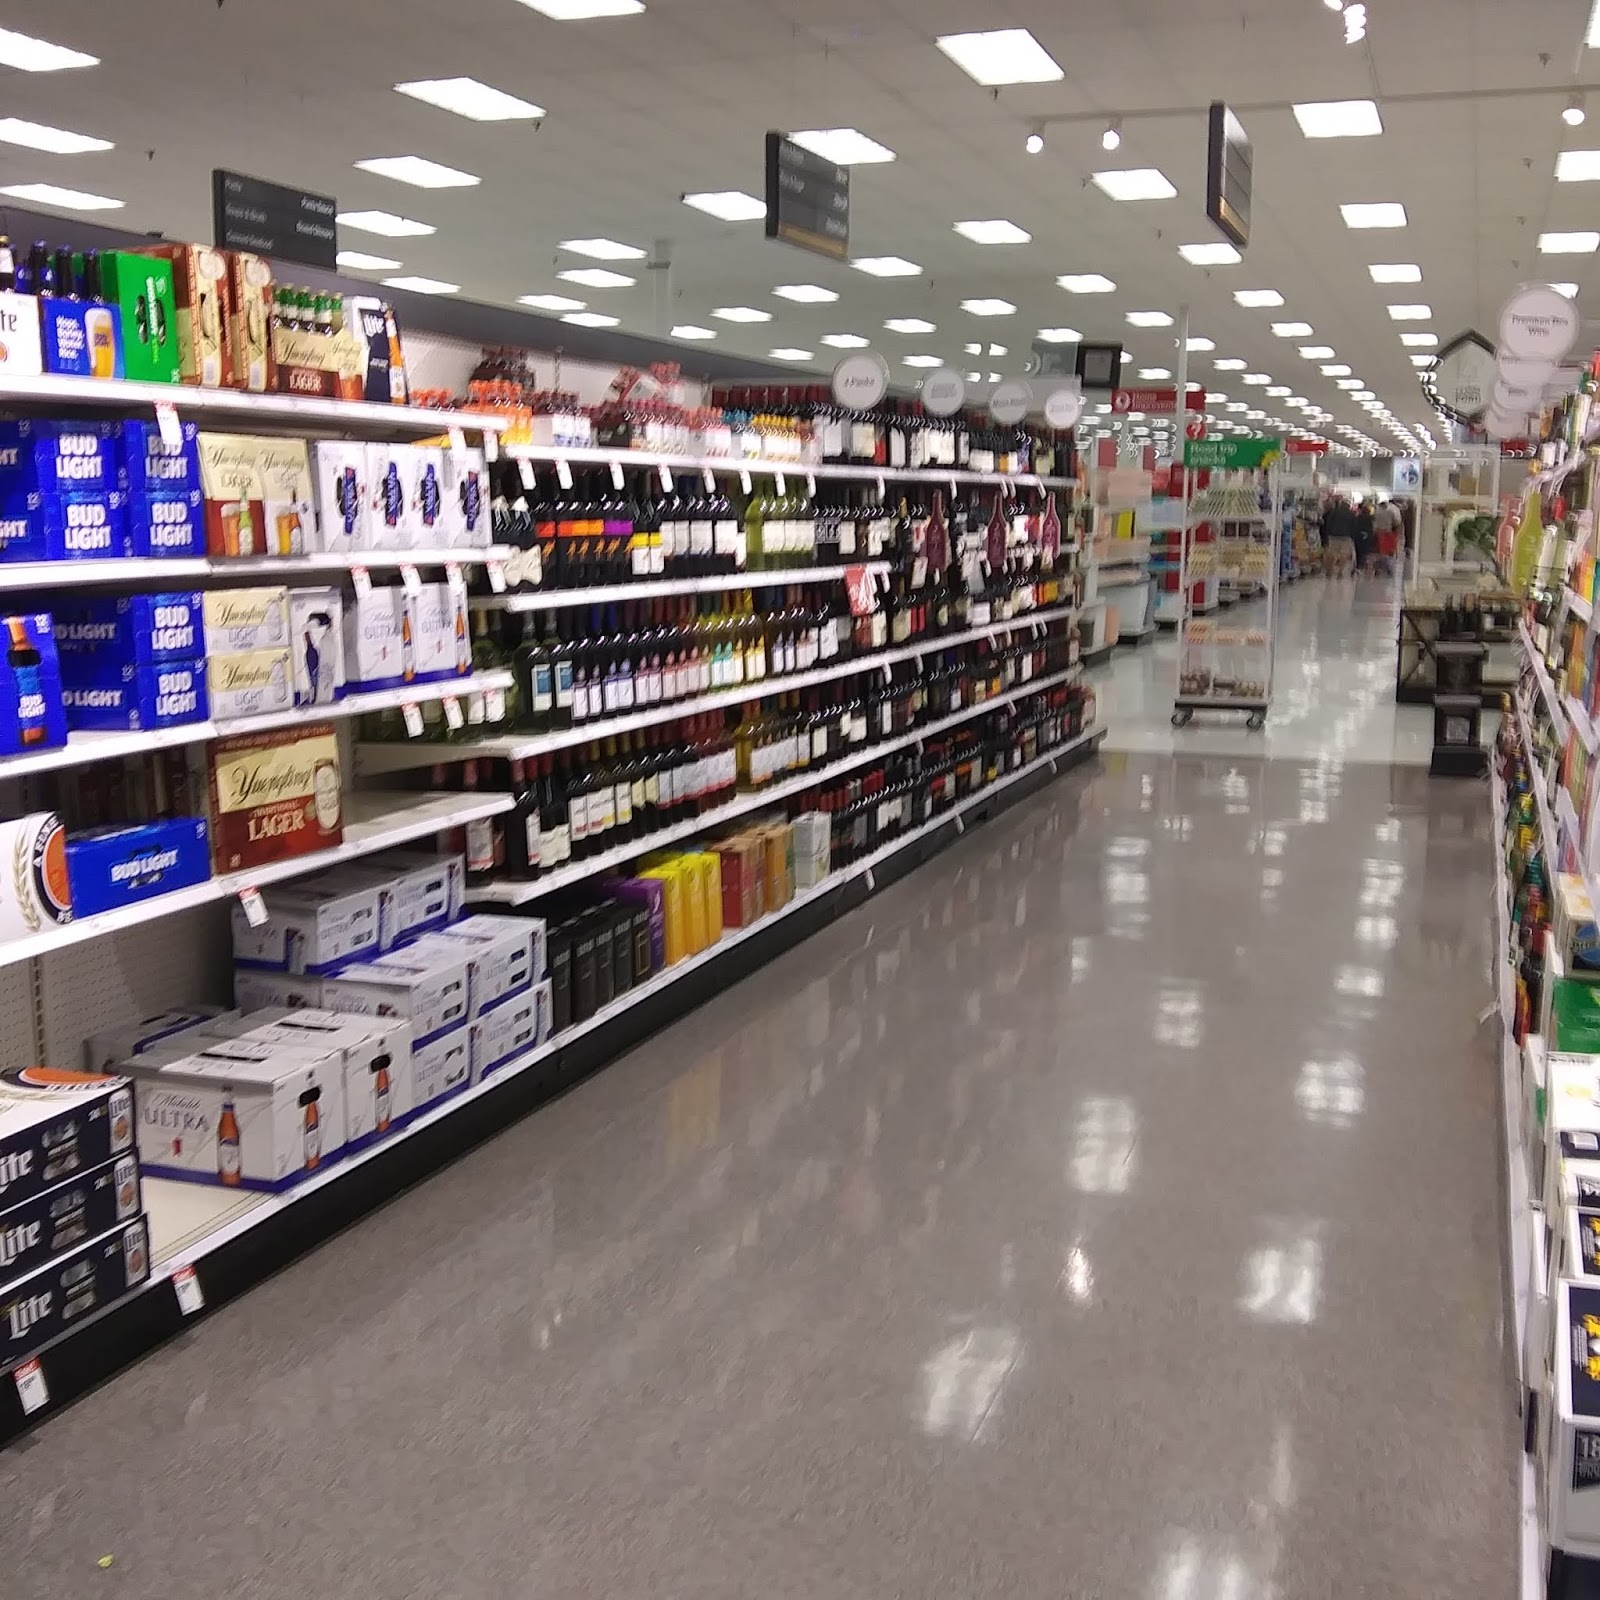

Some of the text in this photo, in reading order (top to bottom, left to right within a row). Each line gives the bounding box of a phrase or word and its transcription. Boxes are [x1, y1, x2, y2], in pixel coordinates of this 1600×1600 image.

[59, 434, 98, 456] BUD
[55, 456, 102, 479] LIGHT
[145, 456, 188, 479] LIGHT
[66, 504, 106, 527] BUD
[152, 501, 188, 524] BUD
[64, 525, 112, 550] LIGHT
[150, 524, 193, 547] LIGHT
[154, 605, 190, 628] BUD
[152, 626, 194, 651] LIGHT
[158, 671, 193, 695] BUD
[20, 694, 43, 708] BUD
[75, 690, 123, 707] LIGHT
[156, 691, 197, 717] LIGHT
[230, 762, 313, 805] Yuengling
[248, 808, 306, 842] LAGER
[111, 858, 141, 883] BUD
[141, 849, 180, 875] LIGHT
[144, 1107, 211, 1133] ULTRA
[9, 1290, 52, 1340] Lite
